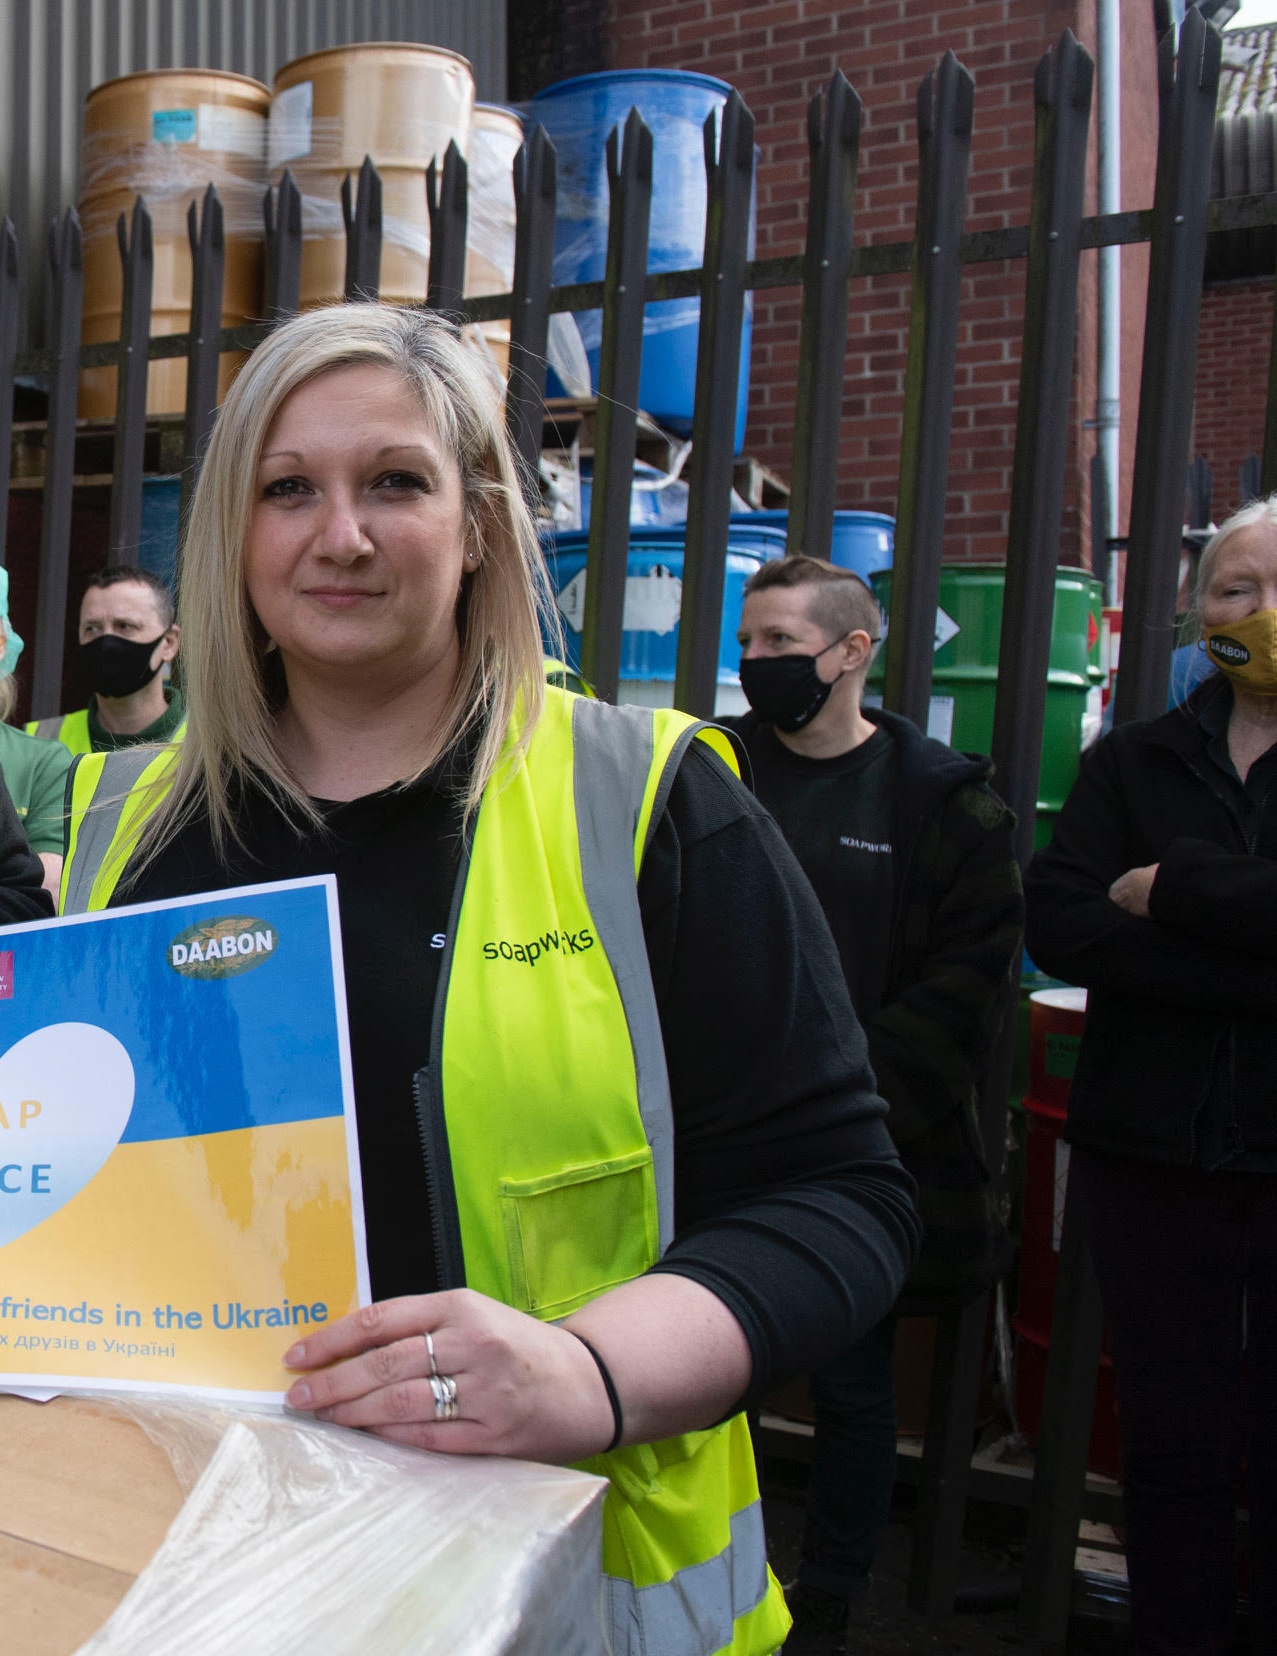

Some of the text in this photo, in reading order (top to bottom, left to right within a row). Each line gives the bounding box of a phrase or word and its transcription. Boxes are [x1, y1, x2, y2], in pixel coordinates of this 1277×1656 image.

[840, 836, 893, 854] SOAPWOR
[172, 930, 273, 966] DAABON
[0, 1296, 104, 1325] friends
[115, 1303, 142, 1328] in
[153, 1304, 203, 1330] the
[213, 1299, 329, 1330] Ukraine
[14, 1335, 80, 1352] друзів
[86, 1340, 97, 1352] в
[103, 1338, 176, 1358] Україні
